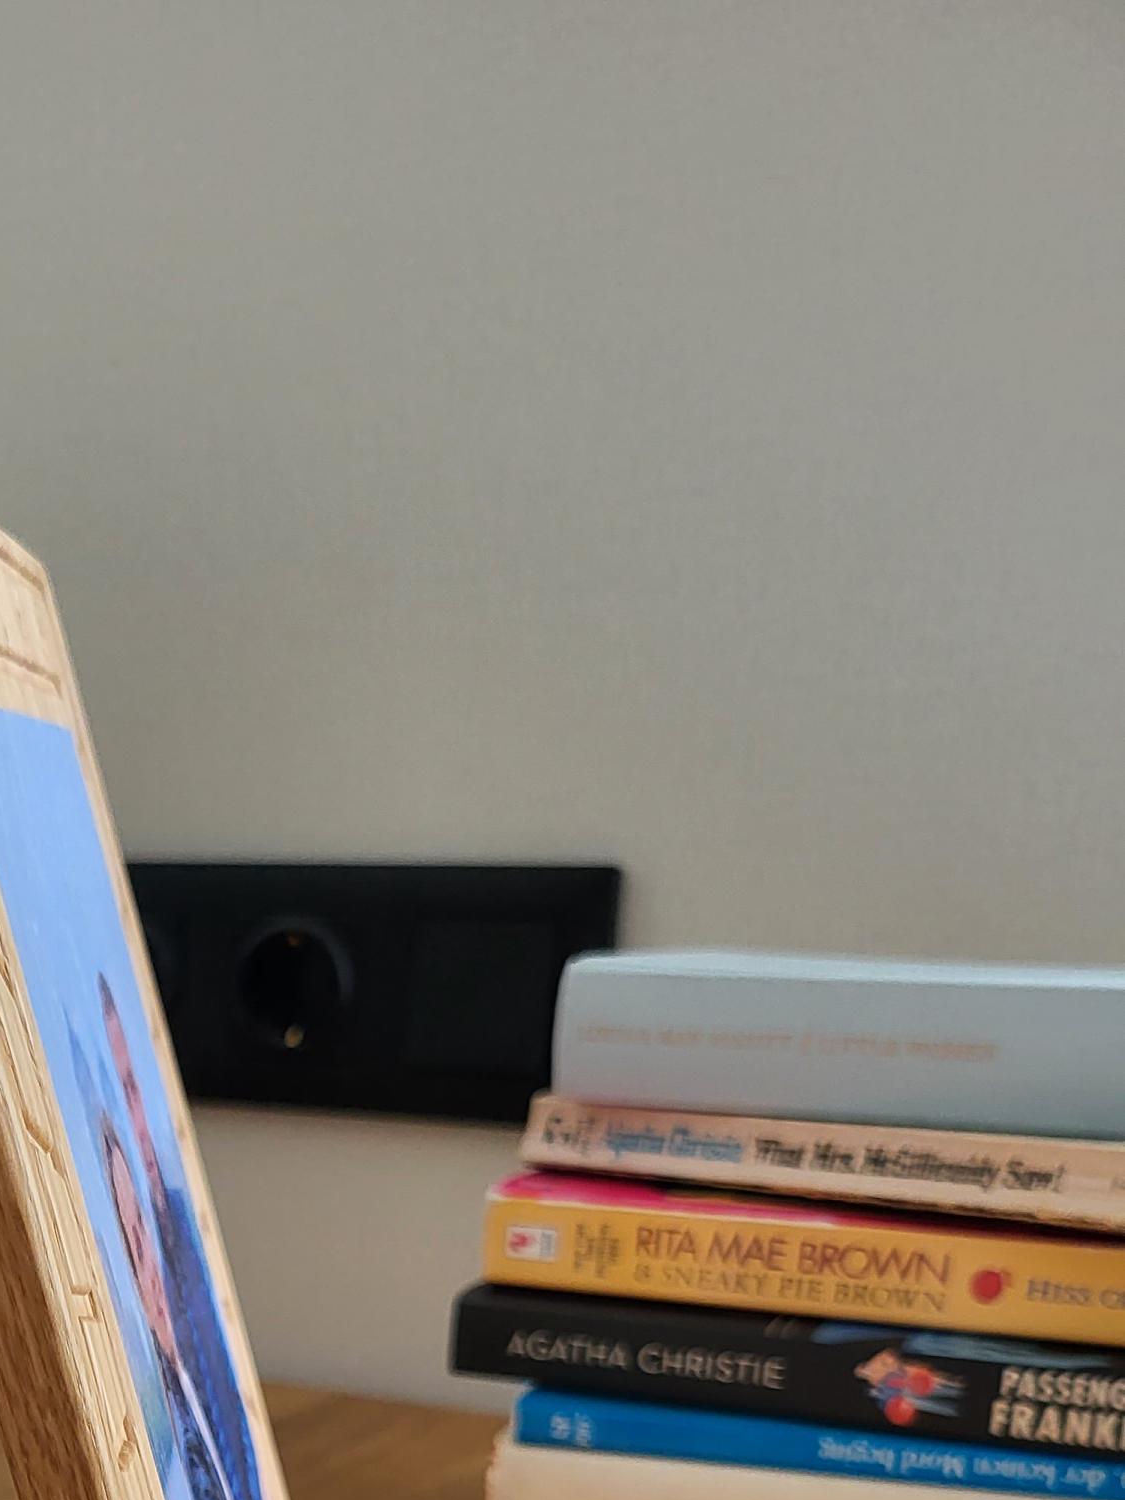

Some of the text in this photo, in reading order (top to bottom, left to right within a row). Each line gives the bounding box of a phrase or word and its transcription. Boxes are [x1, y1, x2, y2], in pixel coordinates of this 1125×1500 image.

[635, 1225, 697, 1263] RITA
[707, 1231, 788, 1272] MAE
[797, 1240, 952, 1286] BROWN
[777, 1276, 823, 1303] PIE
[832, 1282, 948, 1313] BROWN
[506, 1329, 788, 1391] AGATHA CHRISTIE
[988, 1395, 1125, 1451] FRANK
